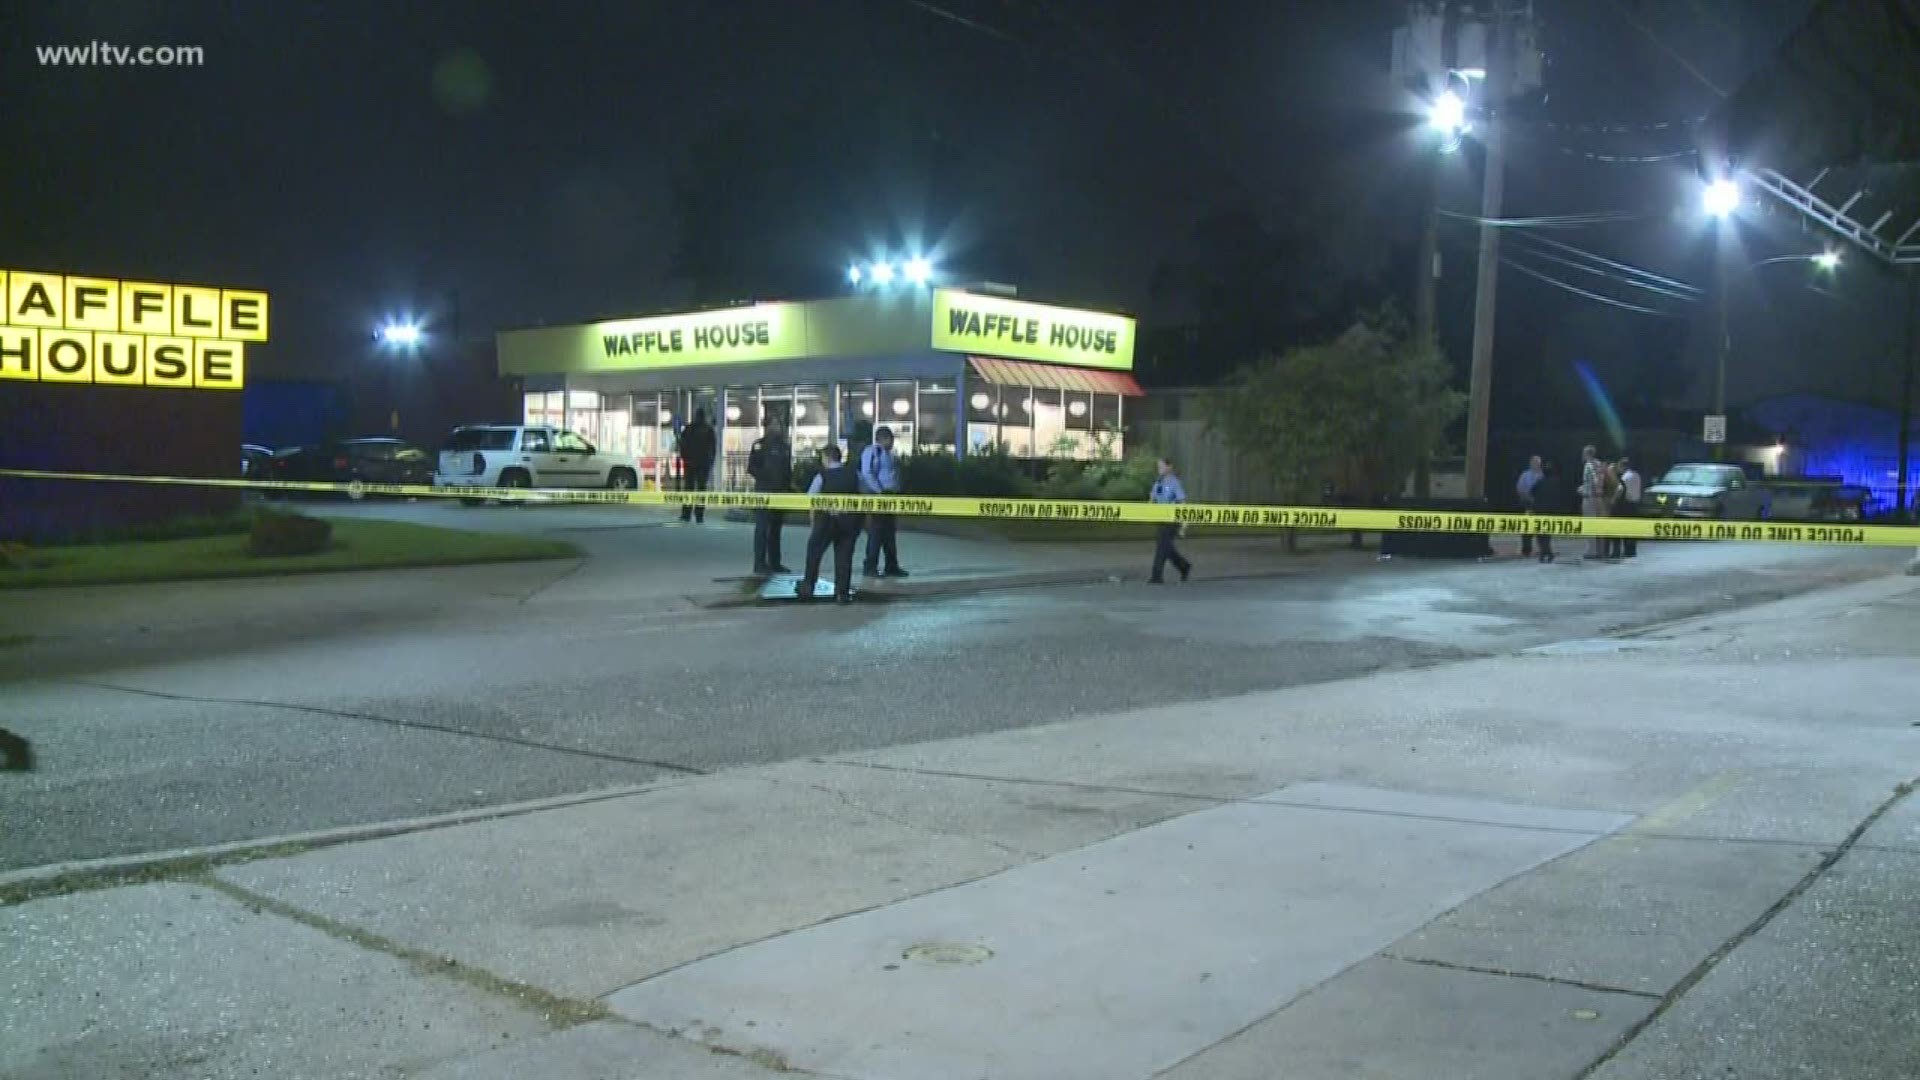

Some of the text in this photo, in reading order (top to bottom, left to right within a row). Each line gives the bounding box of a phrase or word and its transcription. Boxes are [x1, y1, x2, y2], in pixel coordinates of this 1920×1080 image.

[0, 278, 259, 331] AFFLE
[603, 321, 769, 358] WAFFLE HOUSE
[949, 308, 1117, 354] WAFFLE HOUSE
[0, 335, 233, 381] HOUSE
[1056, 504, 1079, 518] LINE
[1082, 504, 1121, 519] POLICE
[1175, 508, 1337, 527] POLICE LINE DO NOT CROSS
[1398, 515, 1582, 534] POLICE LINE DO NOT CROSS
[1653, 522, 1864, 542] POLICE LINE DO NOT CROSS
